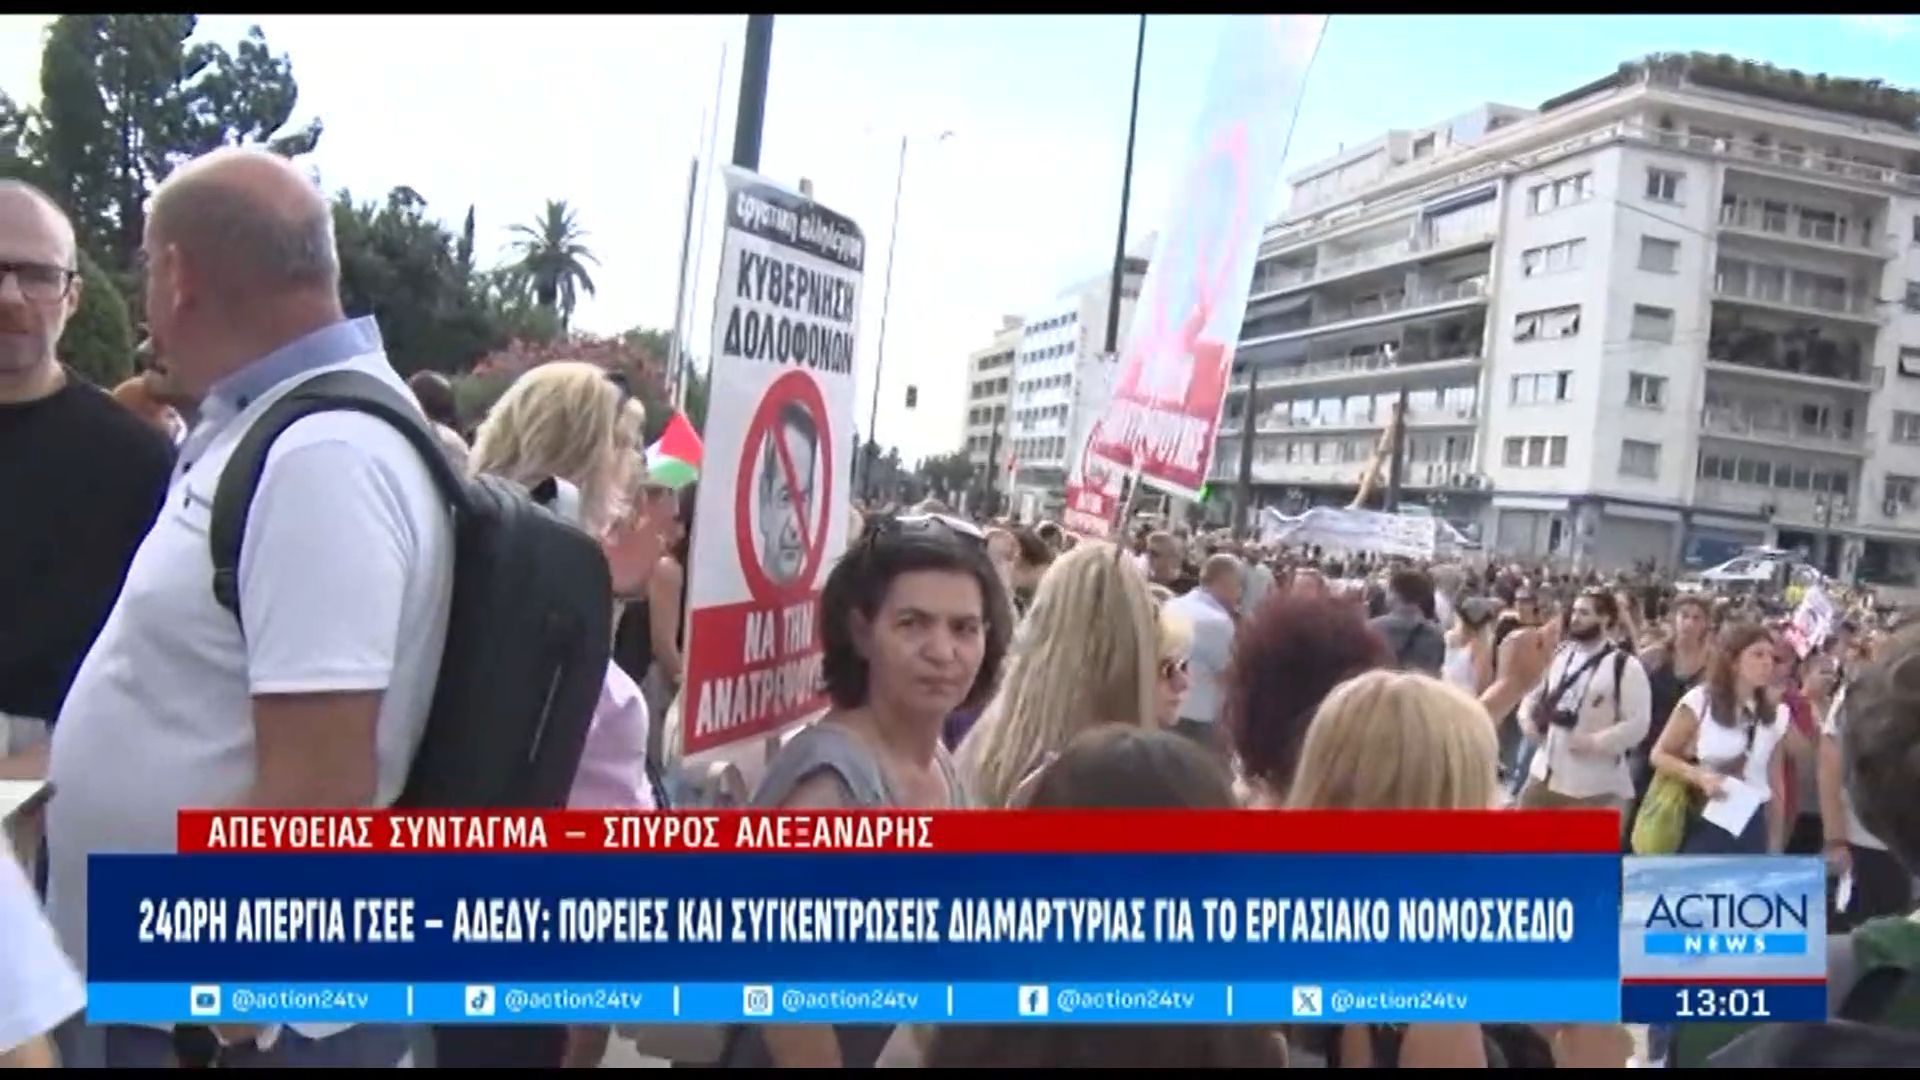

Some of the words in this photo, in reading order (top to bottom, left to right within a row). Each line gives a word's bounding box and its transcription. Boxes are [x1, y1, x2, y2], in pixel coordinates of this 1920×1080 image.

[737, 248, 854, 322] ΚΥΒΕΡΝΗΣΗ
[722, 303, 854, 375] ΔΟΛΟΦΟΝΩΝ
[744, 611, 775, 665] ΝΑ
[784, 600, 814, 654] ΤΗΝ
